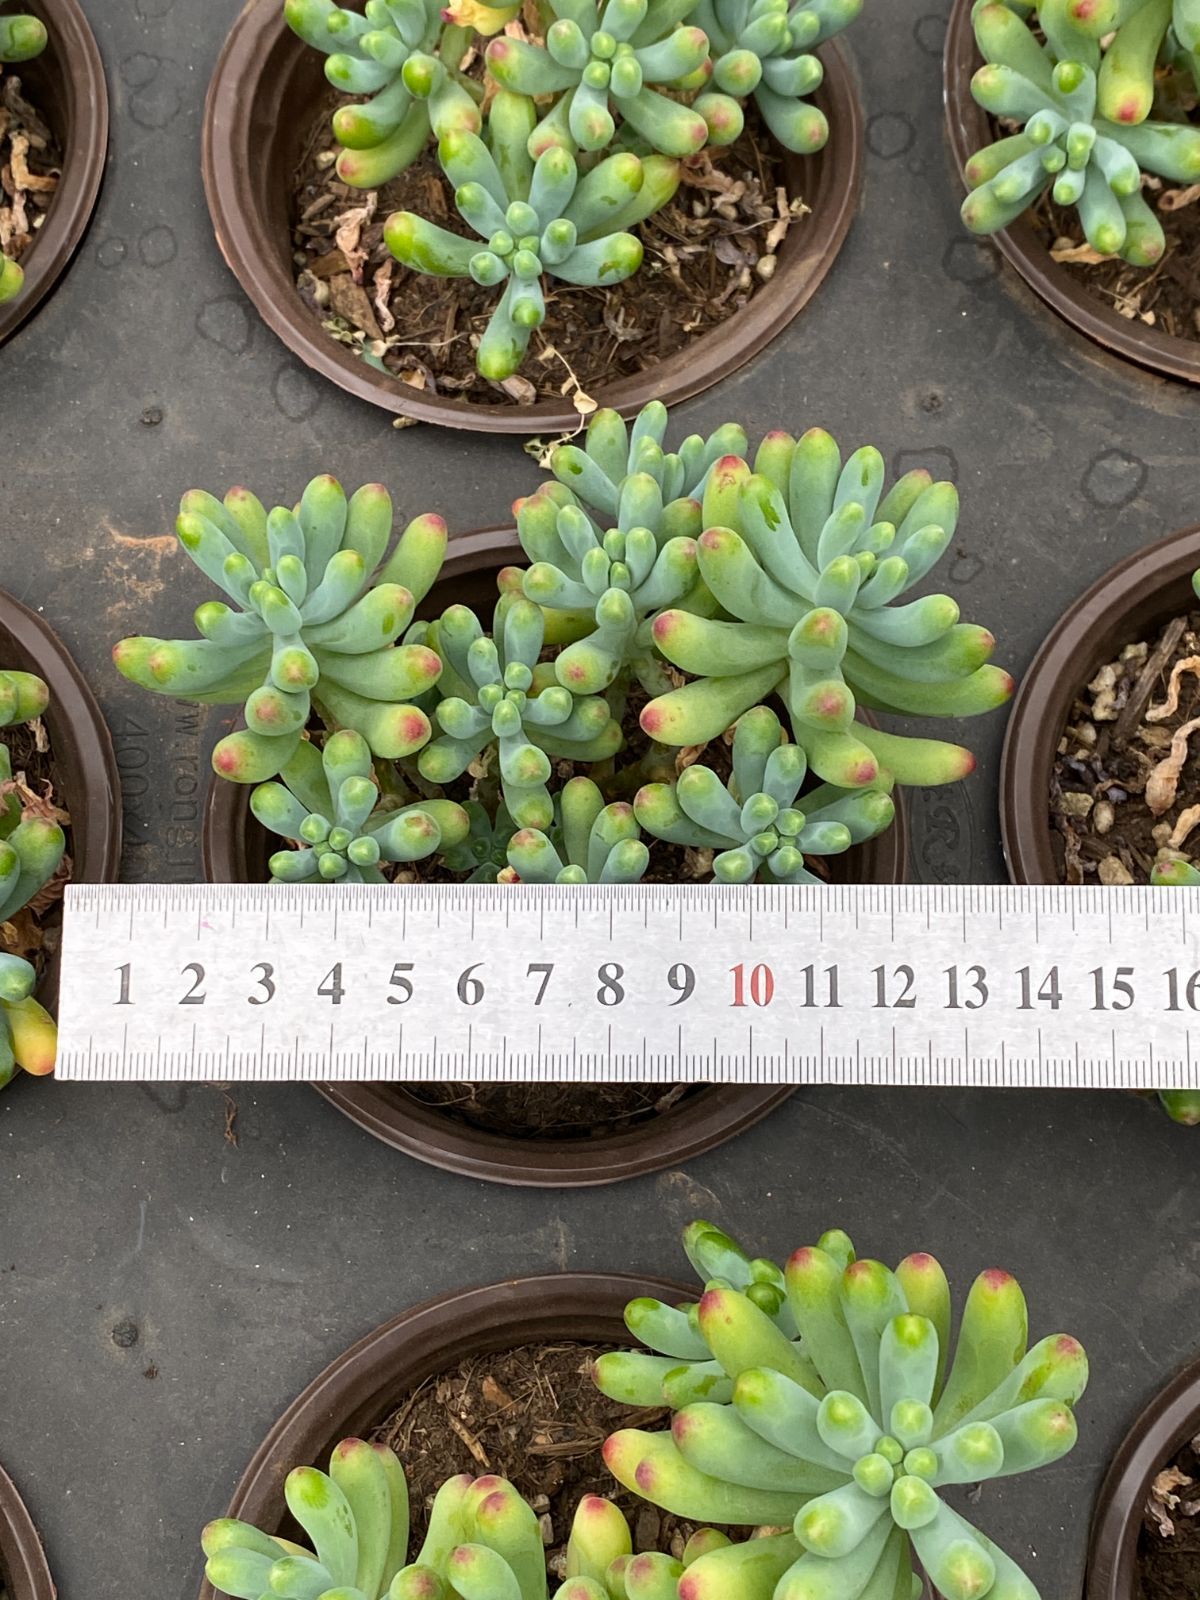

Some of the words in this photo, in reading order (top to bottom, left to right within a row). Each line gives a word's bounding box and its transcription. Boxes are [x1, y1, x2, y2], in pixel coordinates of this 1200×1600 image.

[113, 963, 134, 1005] 1
[178, 962, 207, 1005] 2
[247, 962, 276, 1006] 3
[317, 962, 345, 1005] 4
[386, 963, 415, 1005] 5
[456, 962, 485, 1006] 6
[526, 963, 554, 1006] 7
[596, 962, 625, 1007] 8
[667, 962, 696, 1007] 9
[729, 963, 775, 1007] 10
[800, 964, 844, 1008] 11
[871, 964, 917, 1009] 12
[943, 965, 989, 1010] 13
[1015, 965, 1063, 1010] 14
[1089, 966, 1135, 1011] 15
